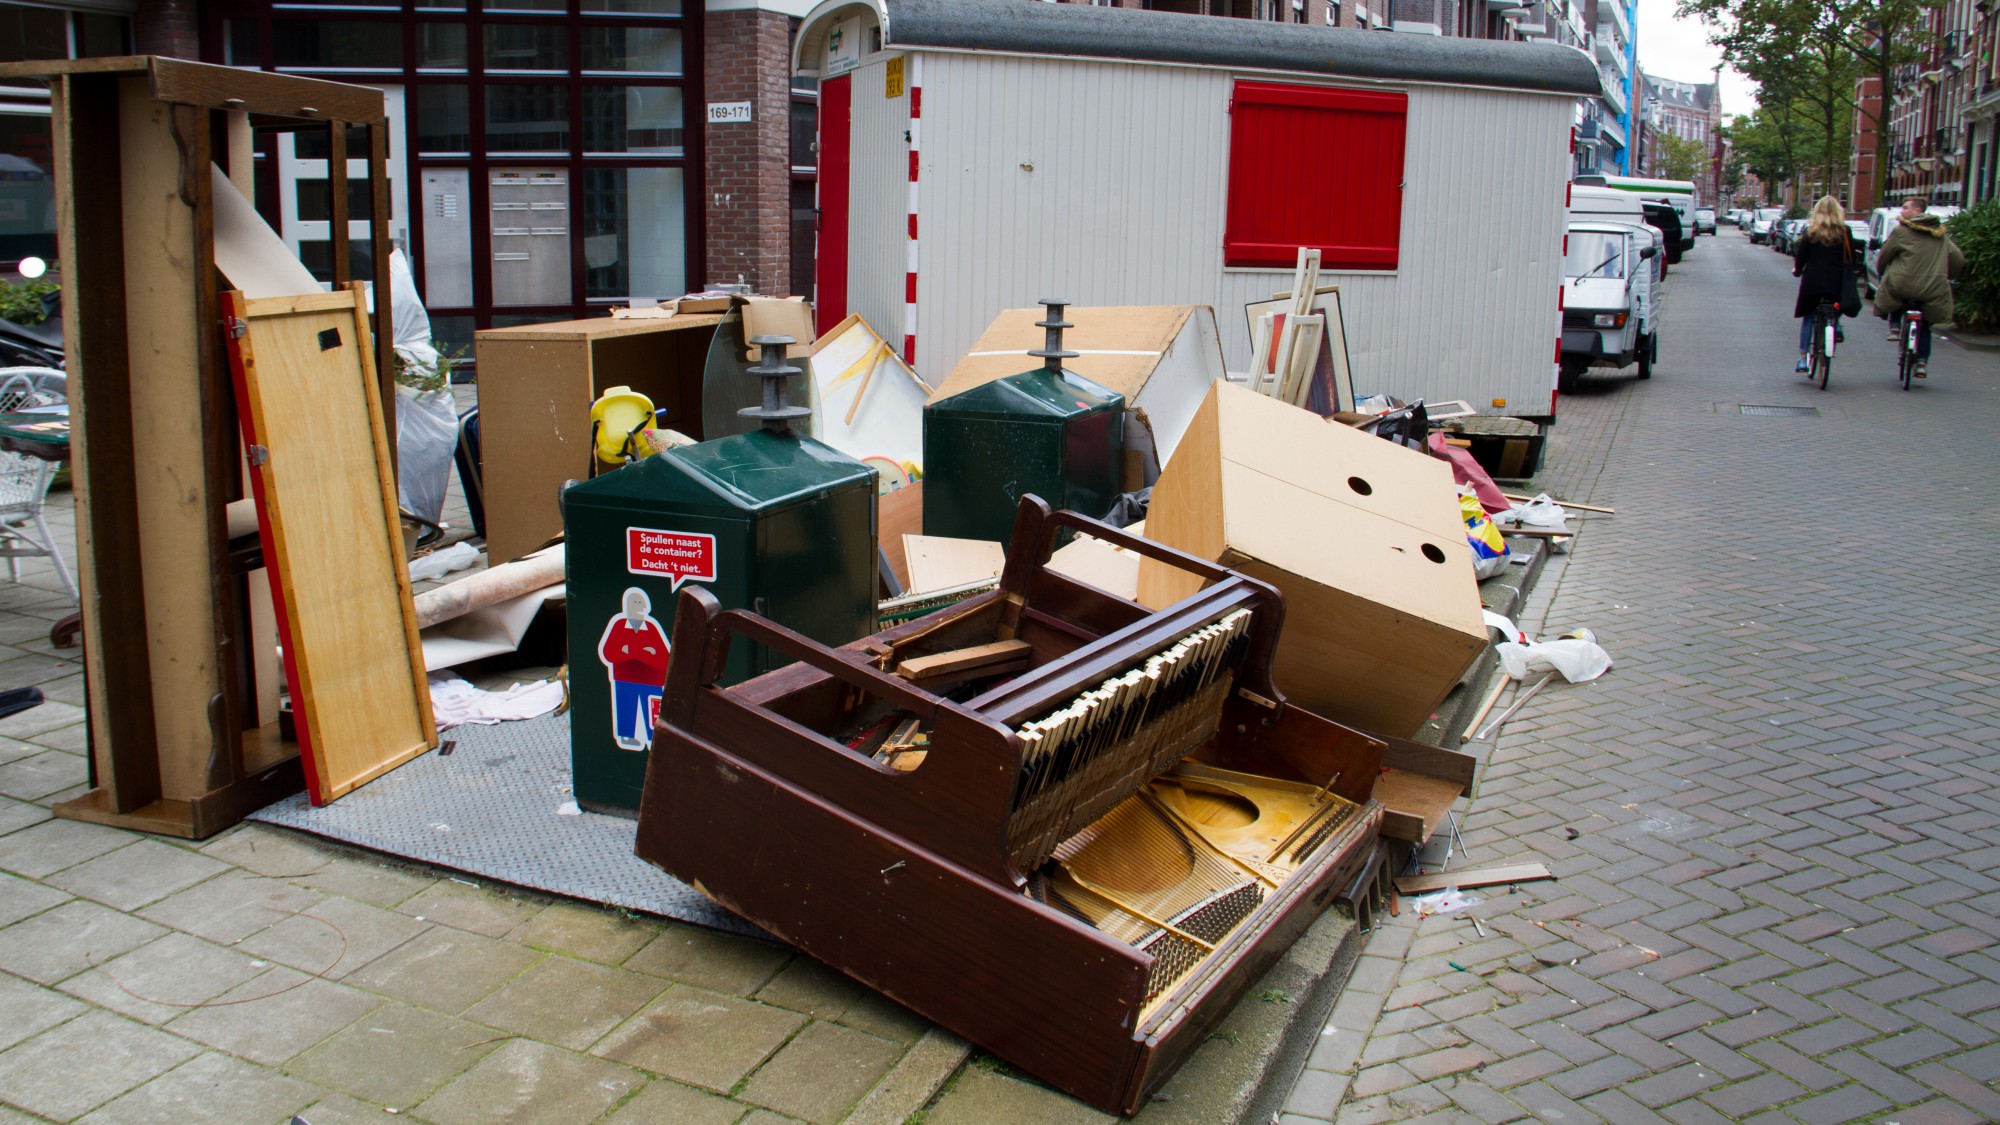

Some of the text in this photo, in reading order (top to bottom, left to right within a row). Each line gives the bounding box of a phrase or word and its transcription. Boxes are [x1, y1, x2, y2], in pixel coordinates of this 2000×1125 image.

[710, 106, 749, 118] 169-171
[640, 533, 701, 548] Spullen naast
[640, 544, 702, 559] de container?
[641, 559, 668, 570] Dacht
[680, 563, 701, 574] niet.
